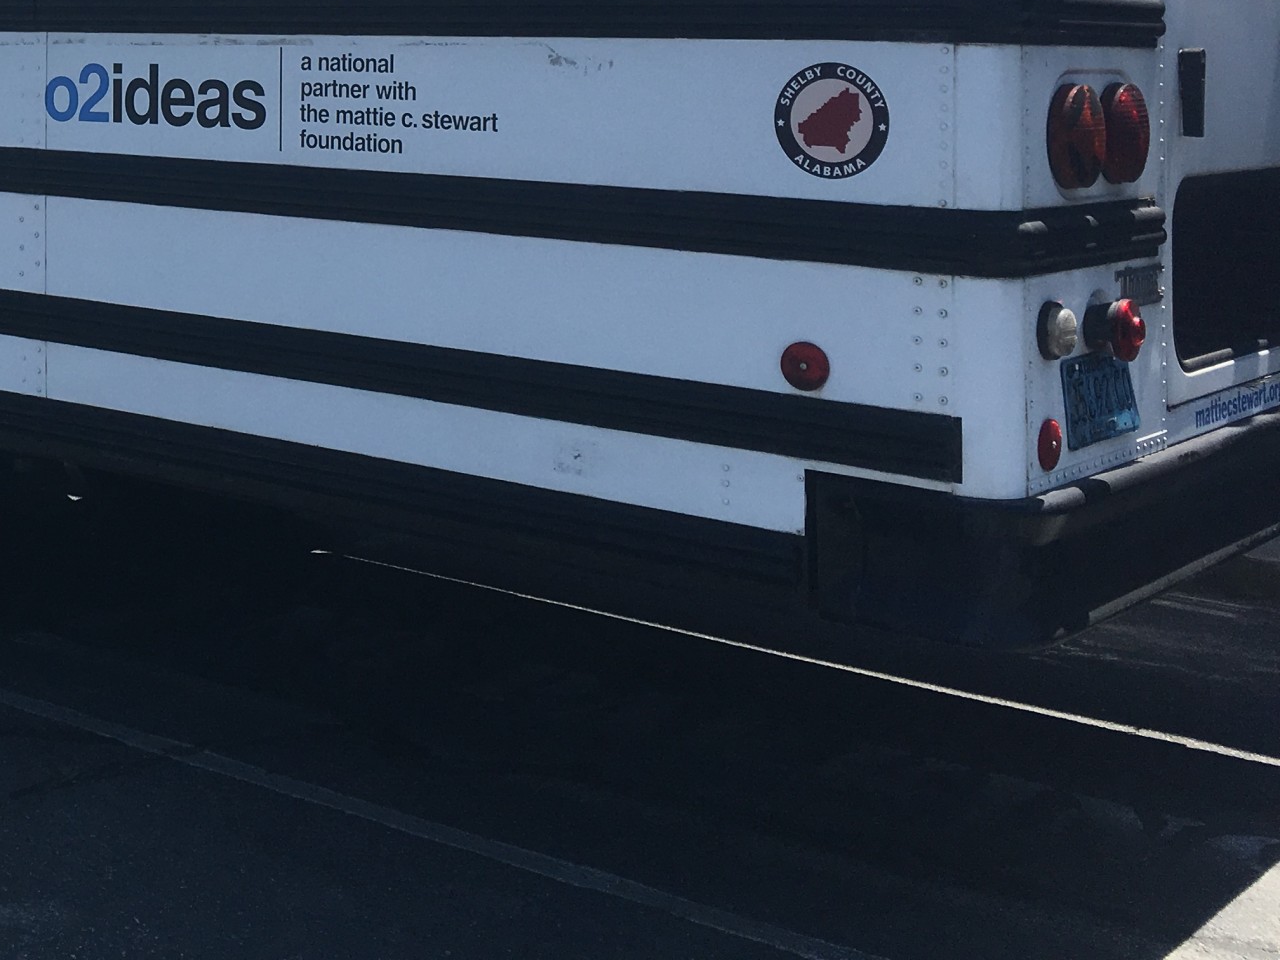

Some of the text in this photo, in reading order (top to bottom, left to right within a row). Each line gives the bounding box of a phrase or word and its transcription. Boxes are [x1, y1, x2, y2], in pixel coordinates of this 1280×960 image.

[301, 53, 394, 73] a national
[45, 63, 267, 130] o2ideas
[301, 80, 417, 101] partner with
[780, 66, 885, 108] SHELBY COUNTY
[300, 104, 498, 132] the mattie c. stewart
[300, 129, 403, 154] foundation
[794, 154, 867, 177] ALABAMA
[1195, 381, 1280, 429] mattiecstewart.or
